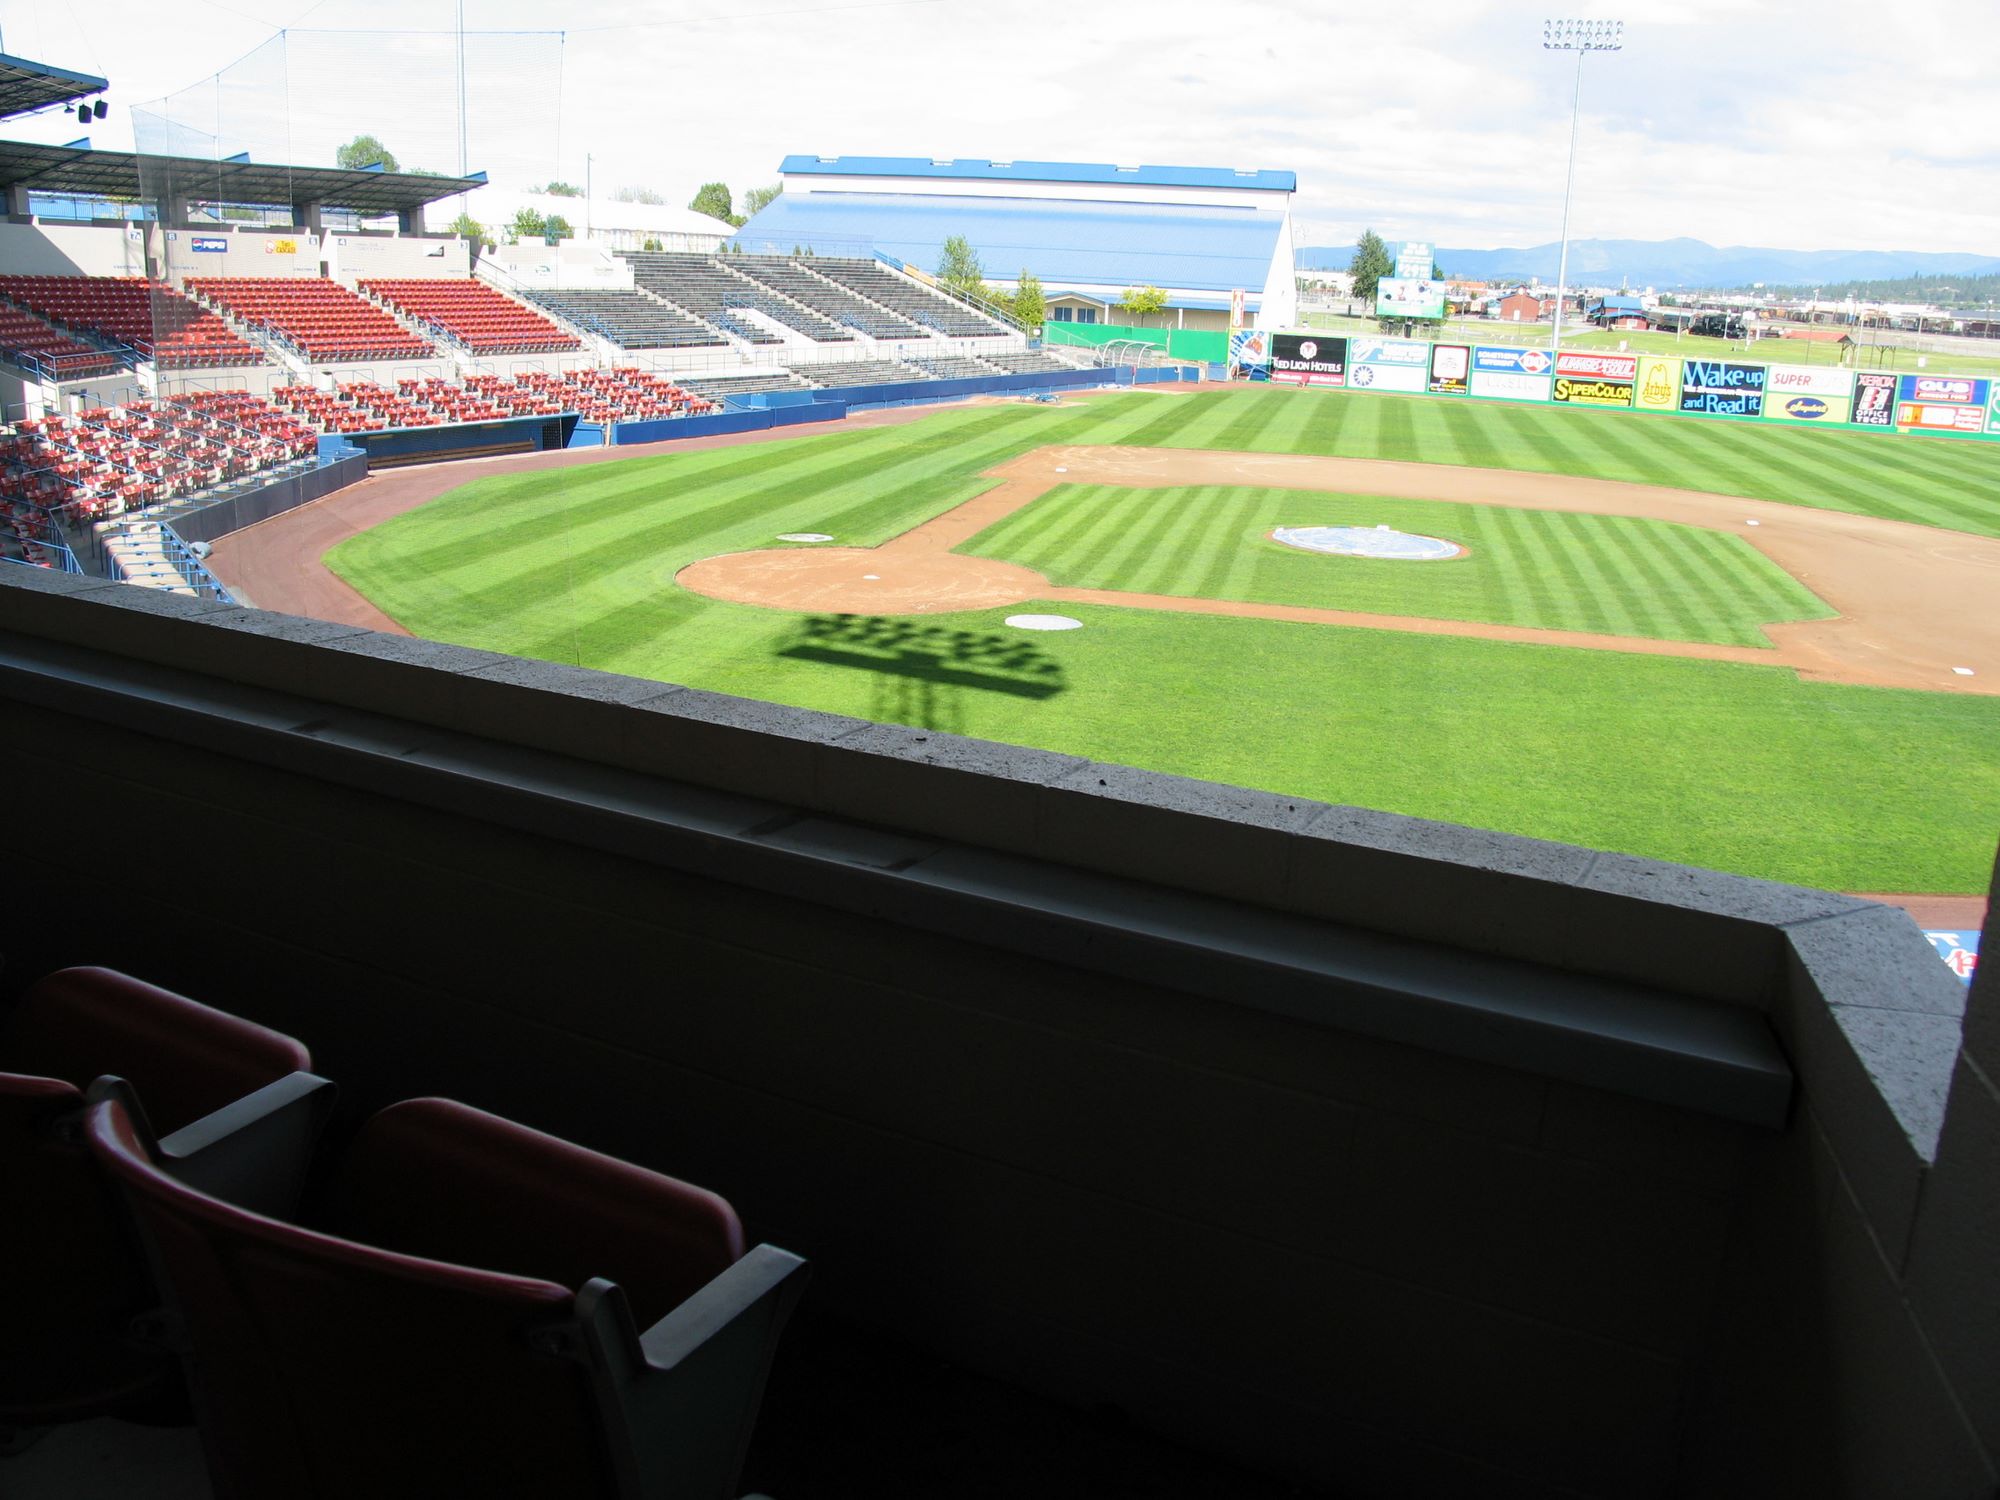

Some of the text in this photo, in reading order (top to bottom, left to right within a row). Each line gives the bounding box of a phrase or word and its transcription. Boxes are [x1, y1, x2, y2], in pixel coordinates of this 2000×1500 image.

[203, 241, 226, 249] PEPSI
[1290, 360, 1310, 371] LION
[1310, 361, 1342, 373] HOTELS
[1683, 361, 1764, 387] Wake up
[1773, 373, 1811, 386] SUPER
[1858, 374, 1895, 388] XEROX
[1643, 382, 1671, 396] Arby's
[1683, 395, 1704, 409] and
[1706, 394, 1745, 413] Read
[1856, 409, 1889, 418] OFFICE
[1856, 416, 1888, 424] TECH
